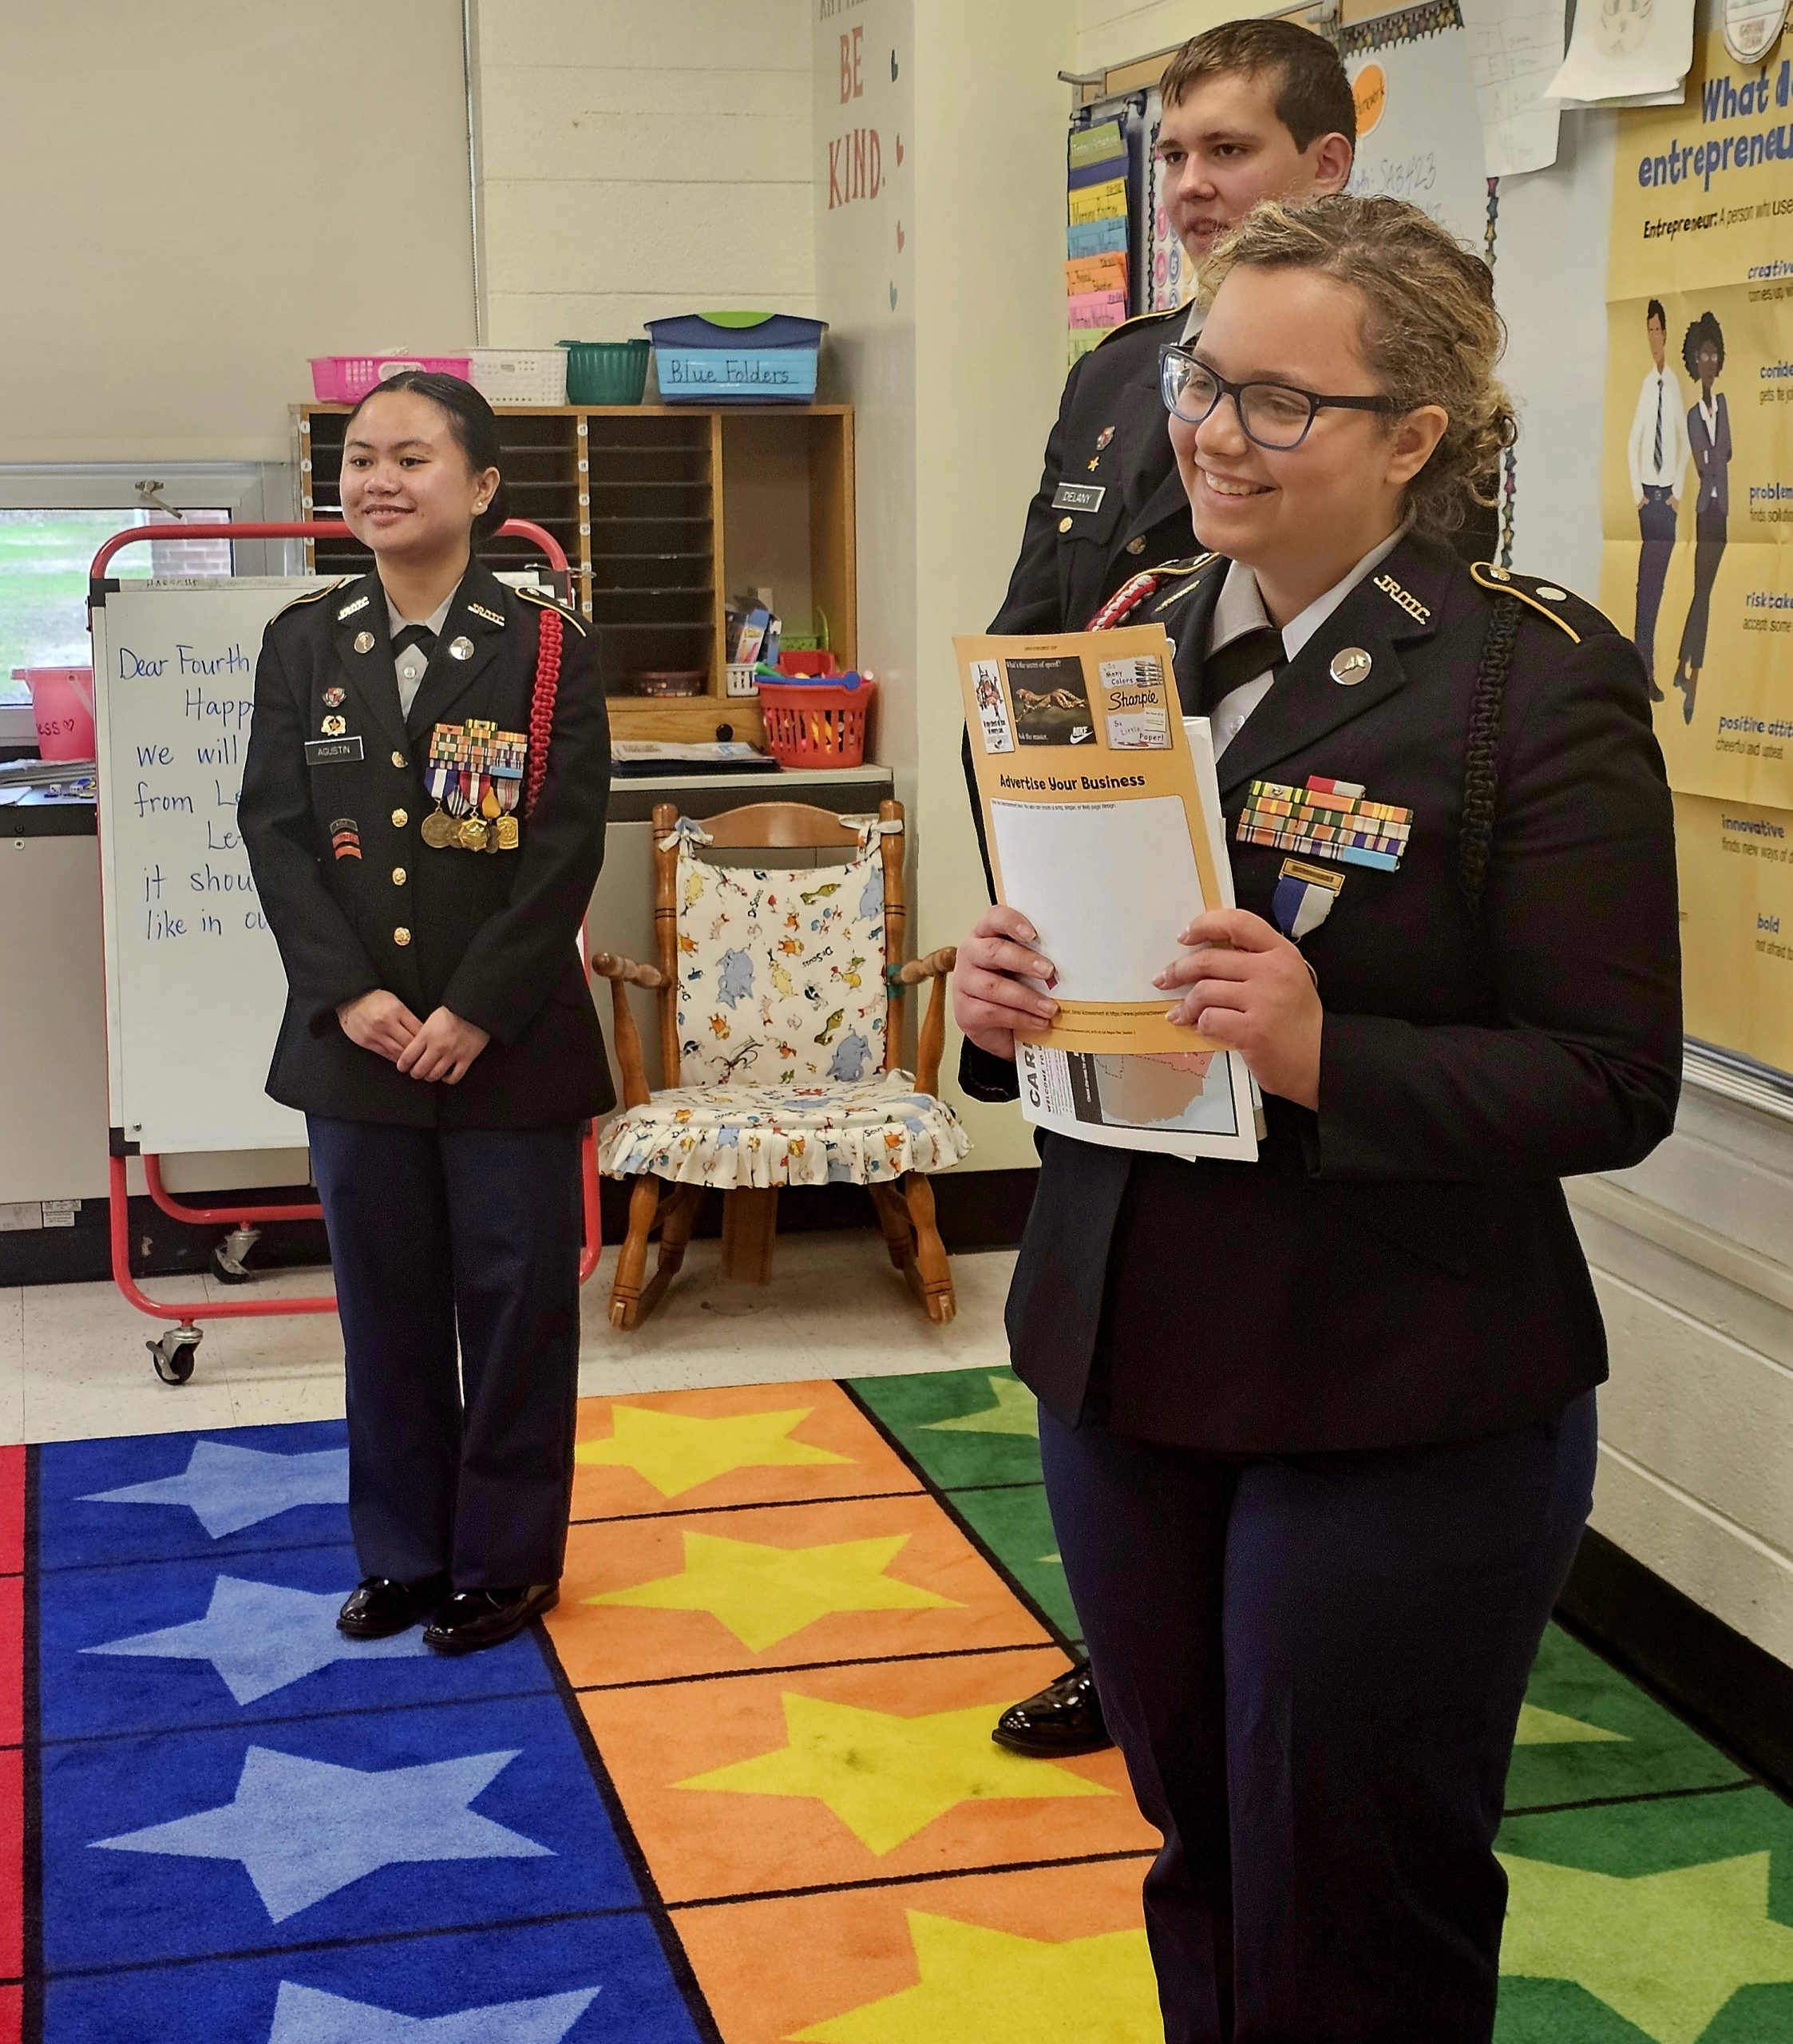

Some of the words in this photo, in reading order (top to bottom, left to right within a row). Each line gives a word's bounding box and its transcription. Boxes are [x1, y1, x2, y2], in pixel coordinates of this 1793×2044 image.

[839, 26, 864, 105] BE
[1702, 65, 1769, 124] What
[1776, 60, 1793, 107] d
[828, 129, 886, 211] KIND.
[1643, 212, 1718, 242] Entrepreneur:
[671, 359, 717, 384] Blue
[726, 359, 790, 384] Folders
[1062, 491, 1092, 504] DELANY
[1373, 574, 1431, 625] JROTC
[1770, 620, 1792, 633] some
[119, 648, 168, 679] Dear
[176, 644, 249, 675] Fourth
[1108, 690, 1158, 711] Sharpie
[1139, 733, 1164, 742] Paper!
[1718, 715, 1765, 735] positive
[197, 735, 237, 766] will
[318, 745, 350, 757] AGUSTIN
[1000, 773, 1047, 790] Advertise
[1048, 776, 1078, 791] Your
[1080, 773, 1146, 790] Business
[134, 781, 194, 818] from
[1721, 814, 1785, 839] innovative
[144, 865, 167, 902] it
[148, 910, 188, 941] like
[202, 909, 222, 935] in
[1757, 912, 1780, 934] bold
[1039, 1055, 1045, 1065] TO
[1042, 1068, 1051, 1112] WELCOME
